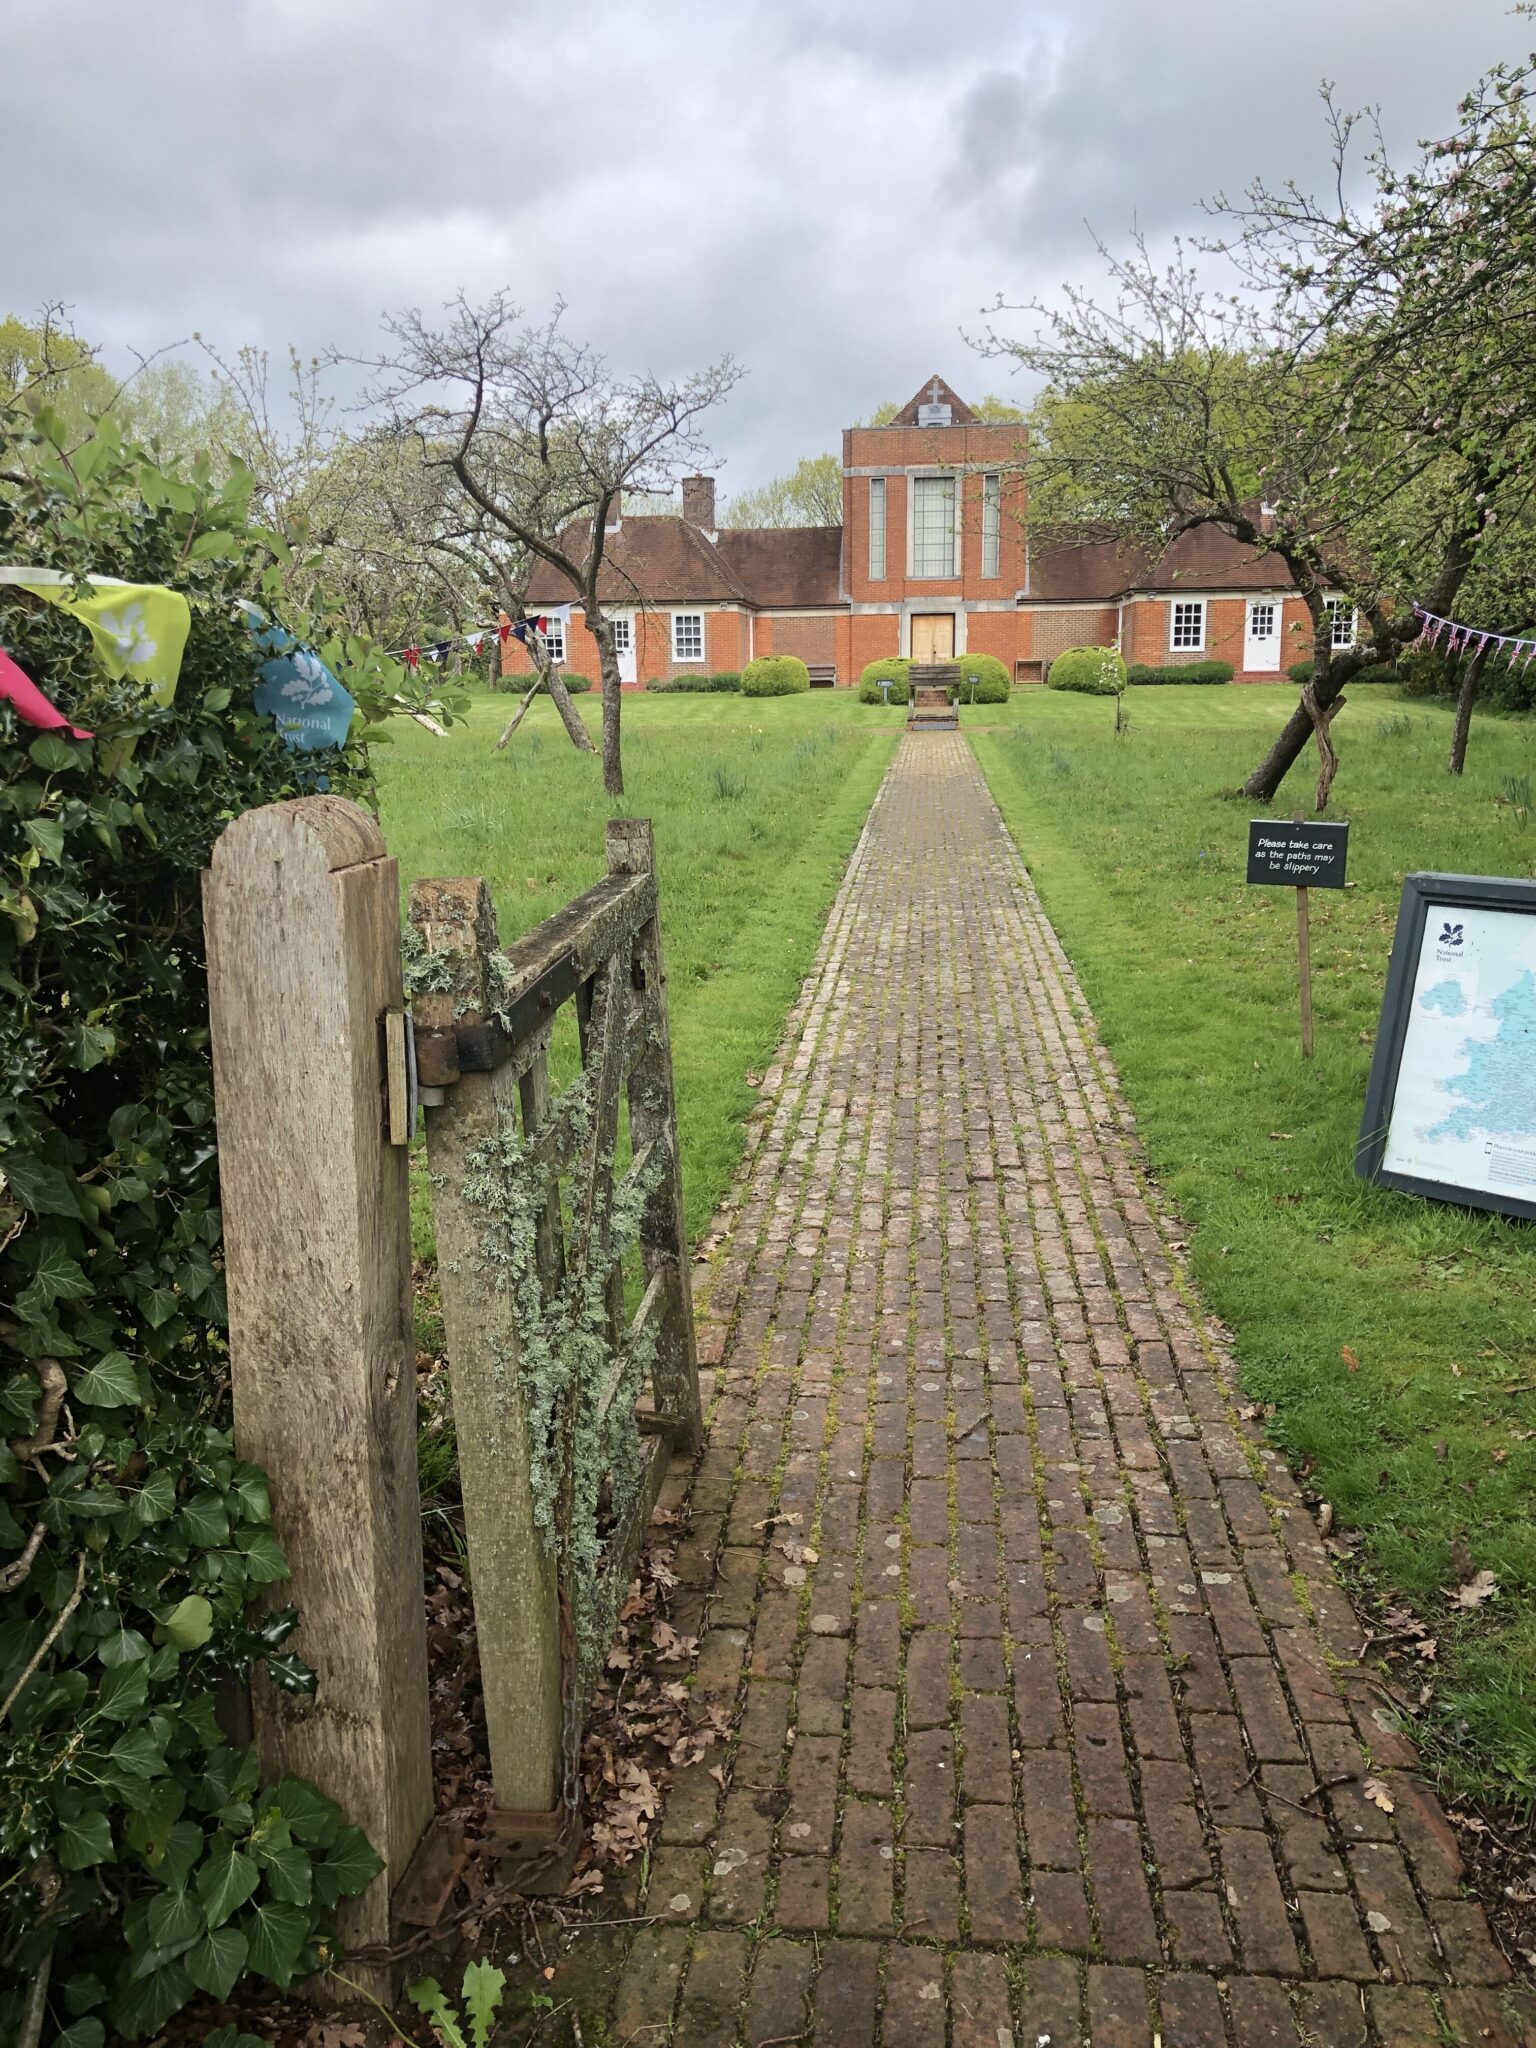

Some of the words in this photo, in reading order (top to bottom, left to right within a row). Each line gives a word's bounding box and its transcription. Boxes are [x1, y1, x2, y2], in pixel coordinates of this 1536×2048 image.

[281, 731, 306, 744] rust
[1257, 838, 1287, 848] Please
[1289, 840, 1309, 849] take
[1312, 842, 1333, 850] care
[1269, 850, 1285, 859] the
[1286, 851, 1312, 861] paths
[1314, 855, 1335, 864] may
[1269, 861, 1281, 870] be
[1283, 862, 1320, 875] slippery
